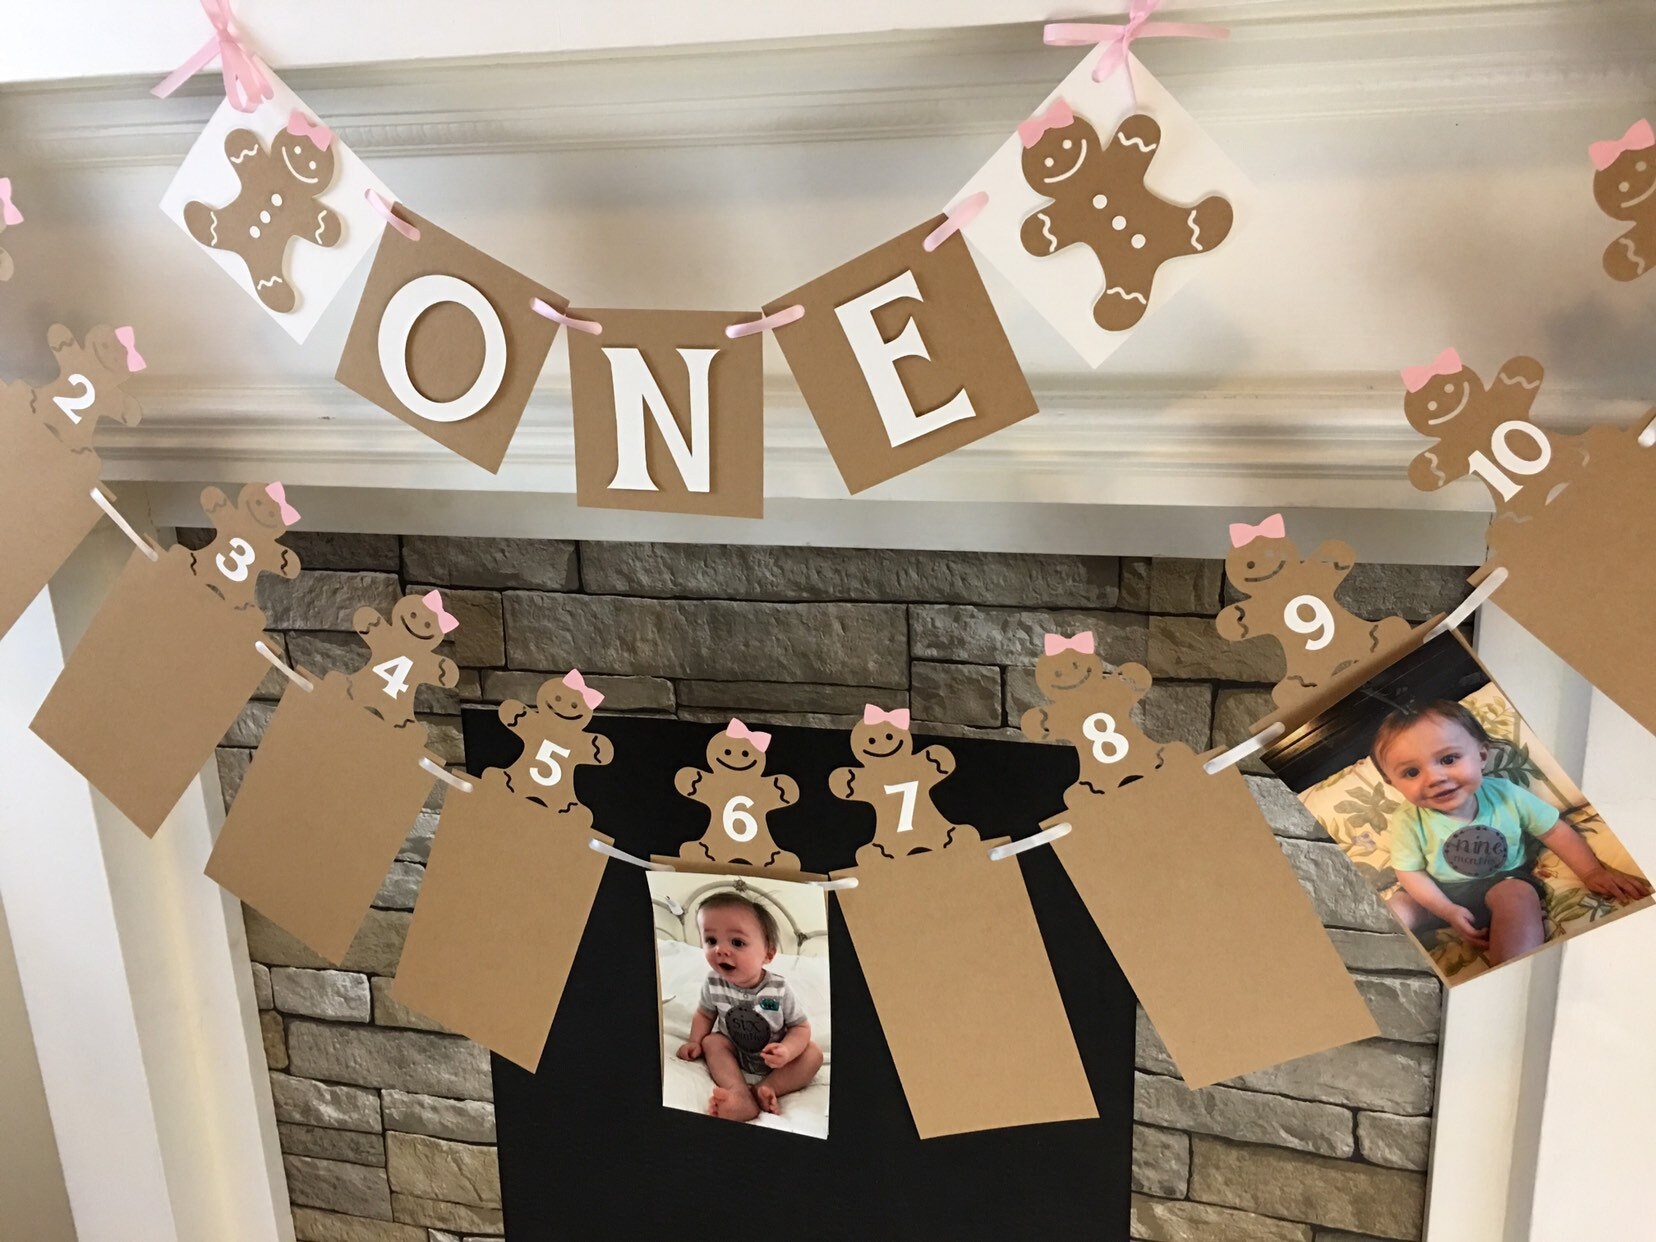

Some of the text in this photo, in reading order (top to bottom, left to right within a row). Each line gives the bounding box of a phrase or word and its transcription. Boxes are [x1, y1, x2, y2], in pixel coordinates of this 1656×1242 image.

[52, 373, 96, 425] 2
[1468, 420, 1552, 502] 10
[216, 538, 256, 582] 3
[1285, 596, 1335, 651] 9
[373, 656, 414, 700] 4
[1083, 713, 1129, 764] 8
[530, 740, 571, 787] 5
[723, 796, 758, 843] 6
[885, 781, 919, 833] 7
[1452, 835, 1503, 855] nine
